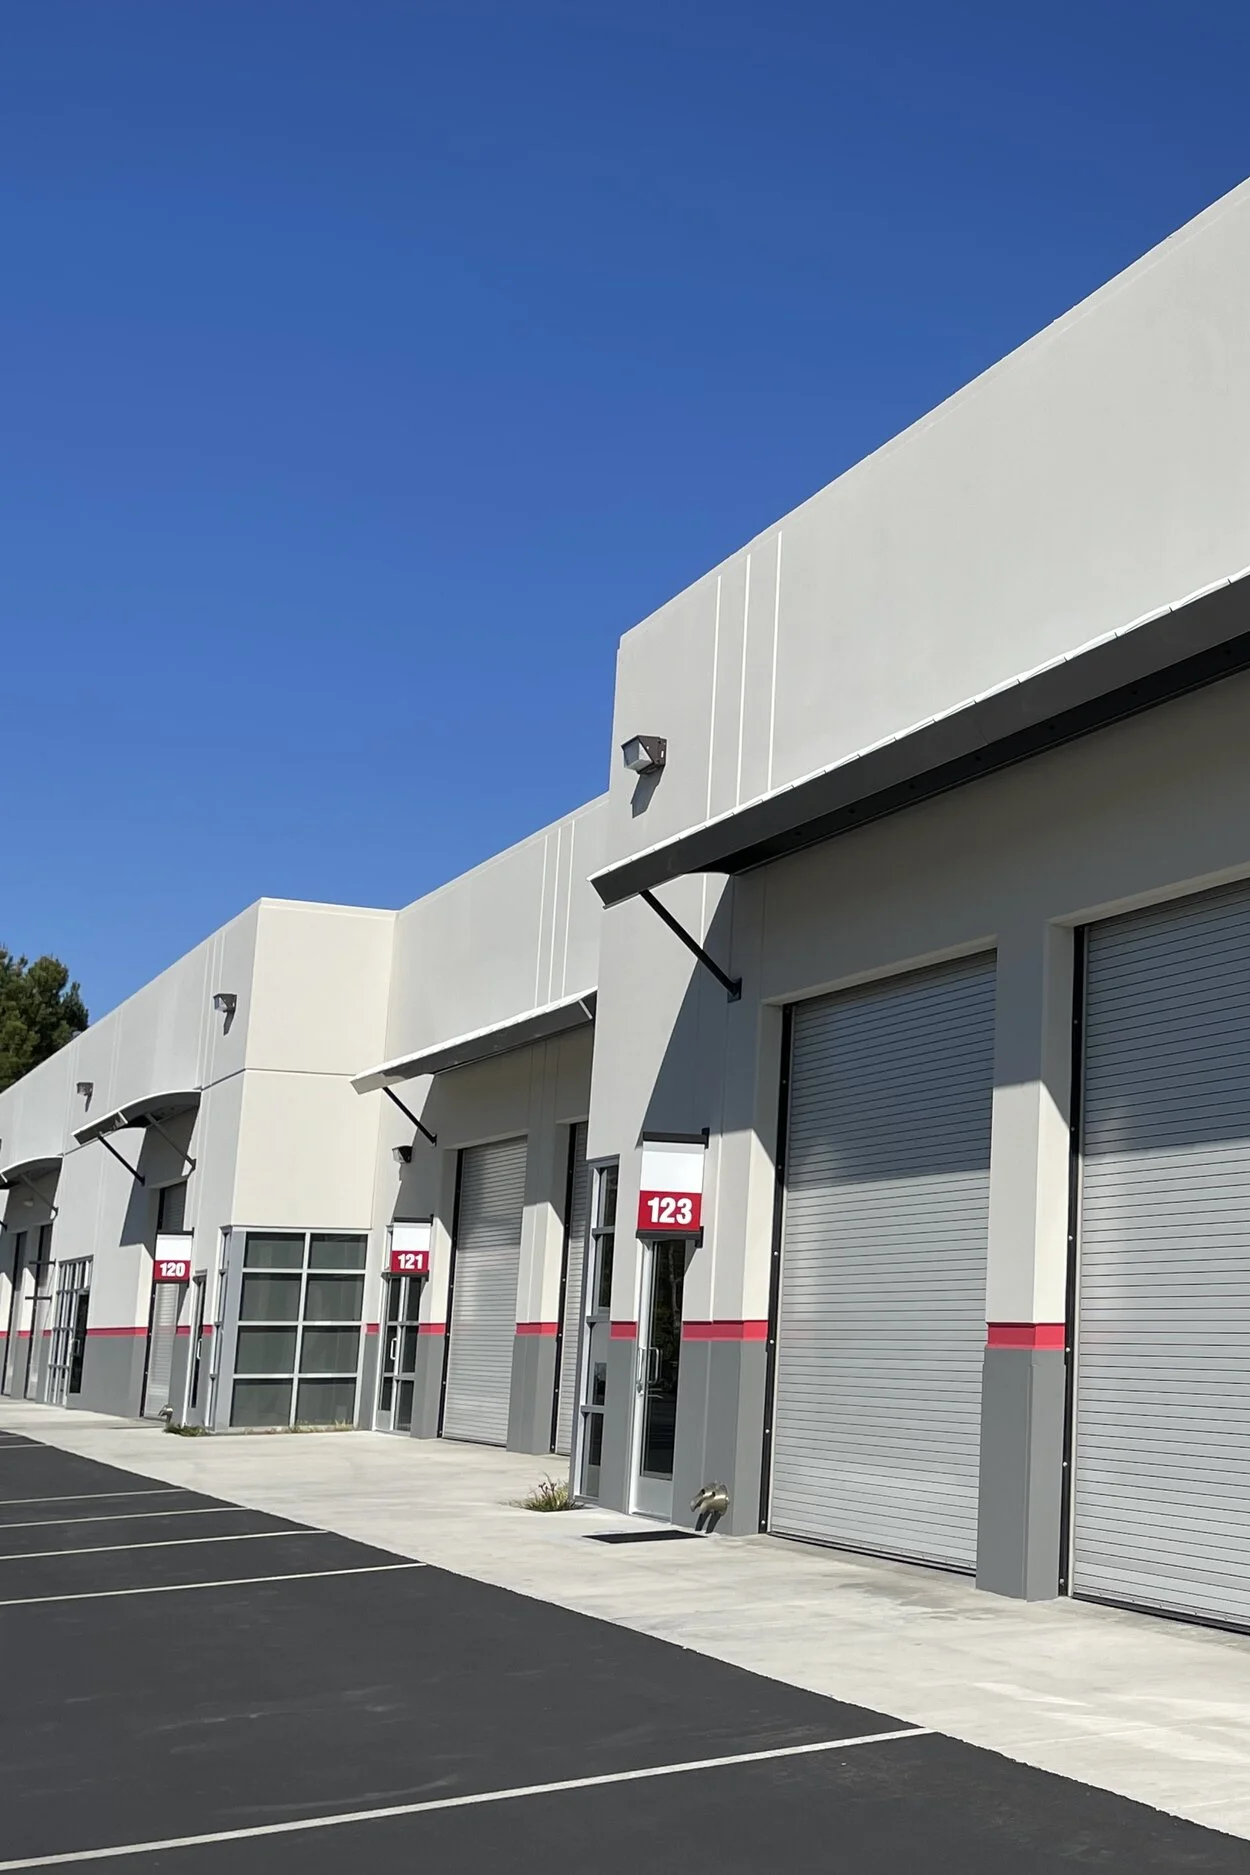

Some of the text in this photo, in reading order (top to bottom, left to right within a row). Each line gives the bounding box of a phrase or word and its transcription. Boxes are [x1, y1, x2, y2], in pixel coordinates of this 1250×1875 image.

[647, 1196, 693, 1225] 123
[159, 1261, 186, 1277] 120
[397, 1253, 423, 1270] 121
